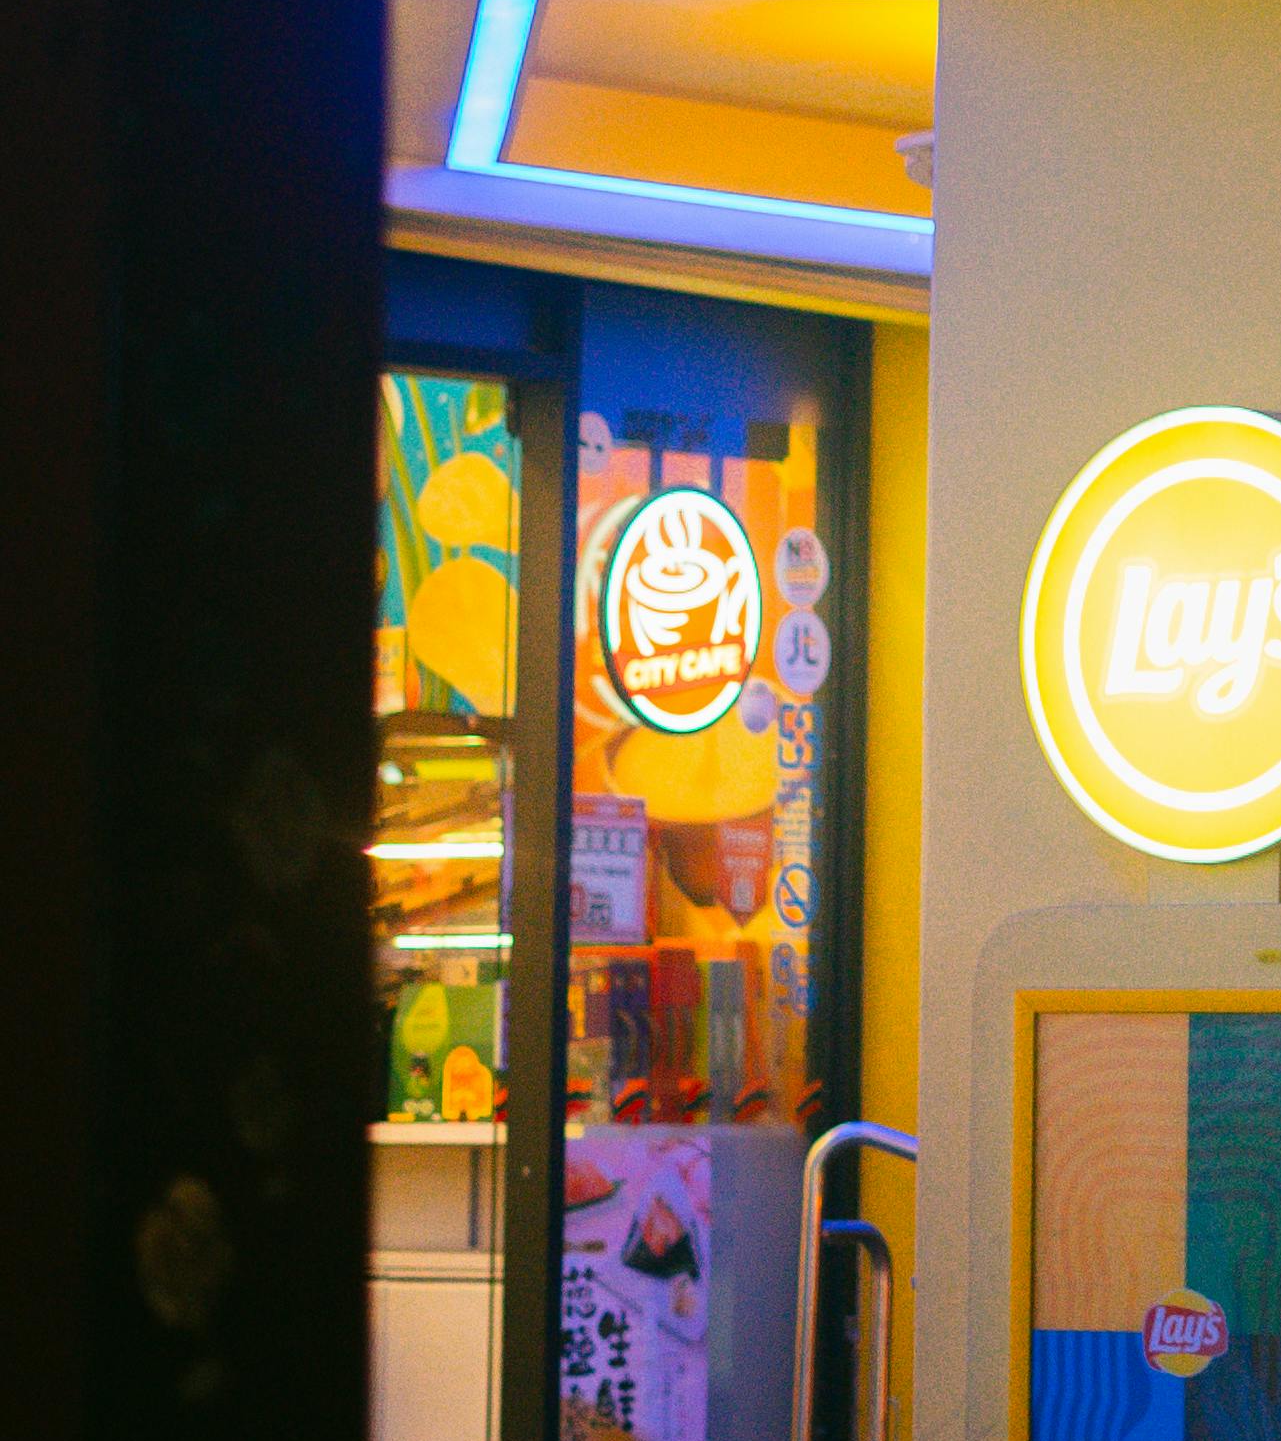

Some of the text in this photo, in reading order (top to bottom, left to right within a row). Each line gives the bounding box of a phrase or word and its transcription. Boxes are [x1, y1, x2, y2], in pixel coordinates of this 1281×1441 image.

[625, 644, 742, 691] CITY CAFE
[1150, 1304, 1227, 1357] Lay's
